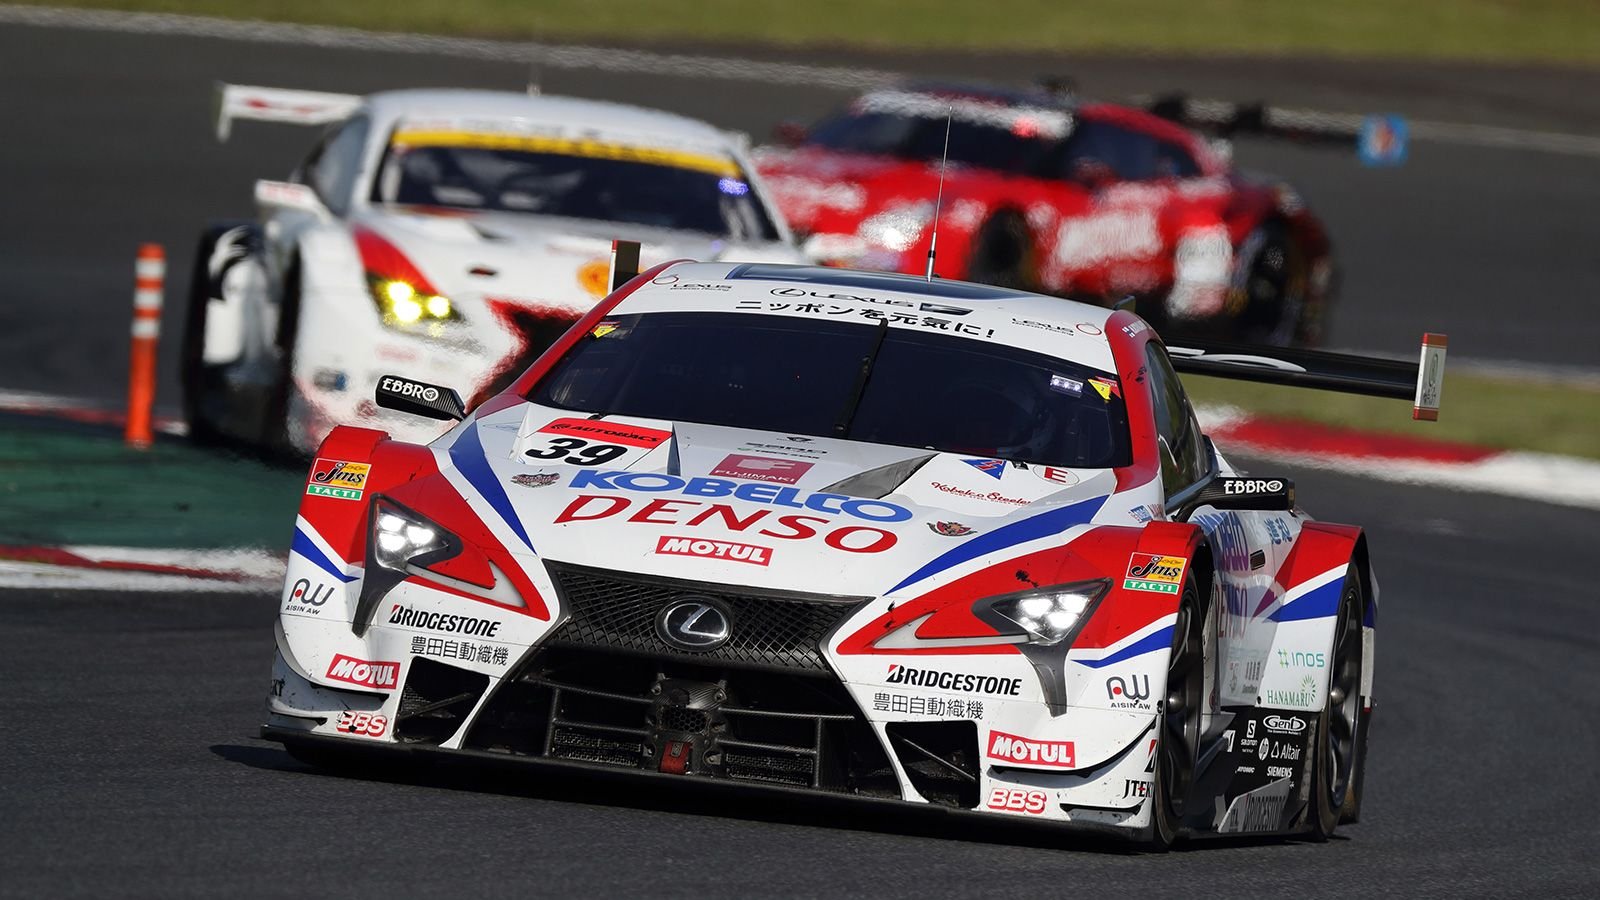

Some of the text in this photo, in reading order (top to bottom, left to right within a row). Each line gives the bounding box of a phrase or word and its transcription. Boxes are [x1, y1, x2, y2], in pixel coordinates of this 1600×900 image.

[810, 291, 915, 308] LEXUS
[382, 378, 439, 401] EBBRO
[572, 426, 661, 443] AUTOBACS
[525, 437, 628, 466] 39
[714, 470, 795, 482] FUJIMAKI
[1223, 480, 1283, 494] EBBRO
[313, 487, 357, 499] TACTI
[568, 469, 913, 522] KOBELCO
[931, 481, 985, 498] Kobelco
[553, 494, 898, 553] DENSO
[662, 538, 767, 563] MOTUL
[1129, 581, 1173, 593] TACTI
[389, 604, 500, 637] BRIDGESTONE
[410, 636, 508, 665] 豊田自動織機
[1291, 650, 1325, 668] inos
[330, 661, 396, 686] MOTUL
[886, 664, 1021, 696] BRIDGESTONE
[873, 692, 984, 720] 豊田自動織機
[1267, 690, 1311, 707] HANAMARU
[337, 710, 387, 737] BBS
[992, 735, 1071, 764] MOTUL
[1280, 743, 1301, 760] Altair
[1266, 766, 1292, 778] SIEMENS
[987, 788, 1047, 815] BBS
